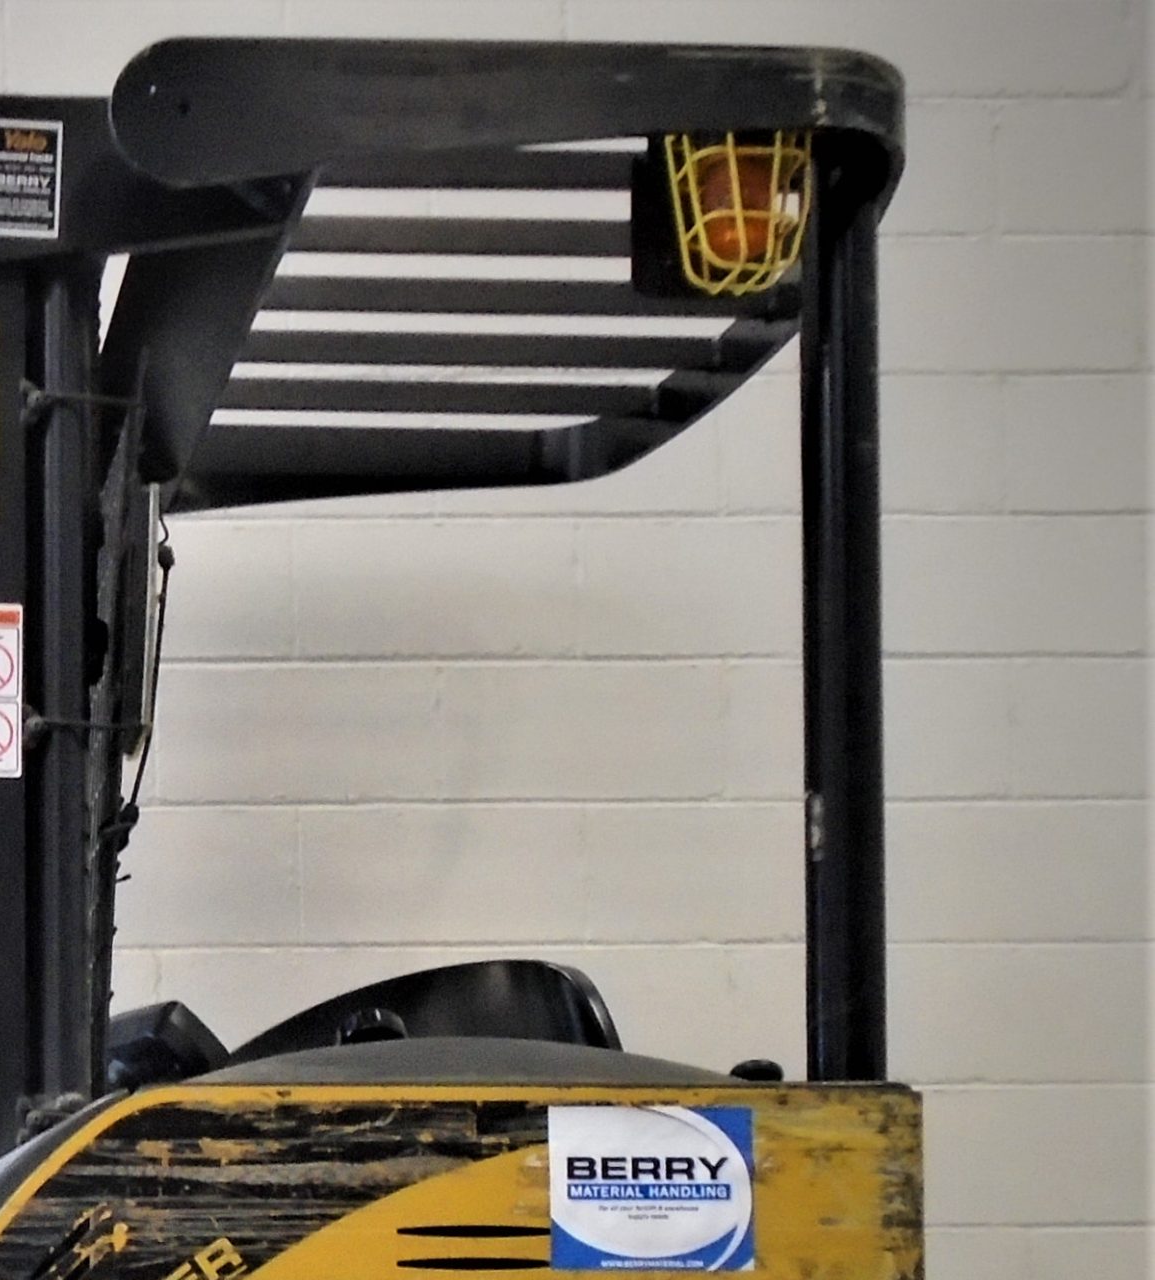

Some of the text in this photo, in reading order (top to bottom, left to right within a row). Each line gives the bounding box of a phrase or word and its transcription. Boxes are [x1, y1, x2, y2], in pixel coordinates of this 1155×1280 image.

[565, 1156, 730, 1181] BERRY
[569, 1184, 729, 1199] MATERIAL HANDLING
